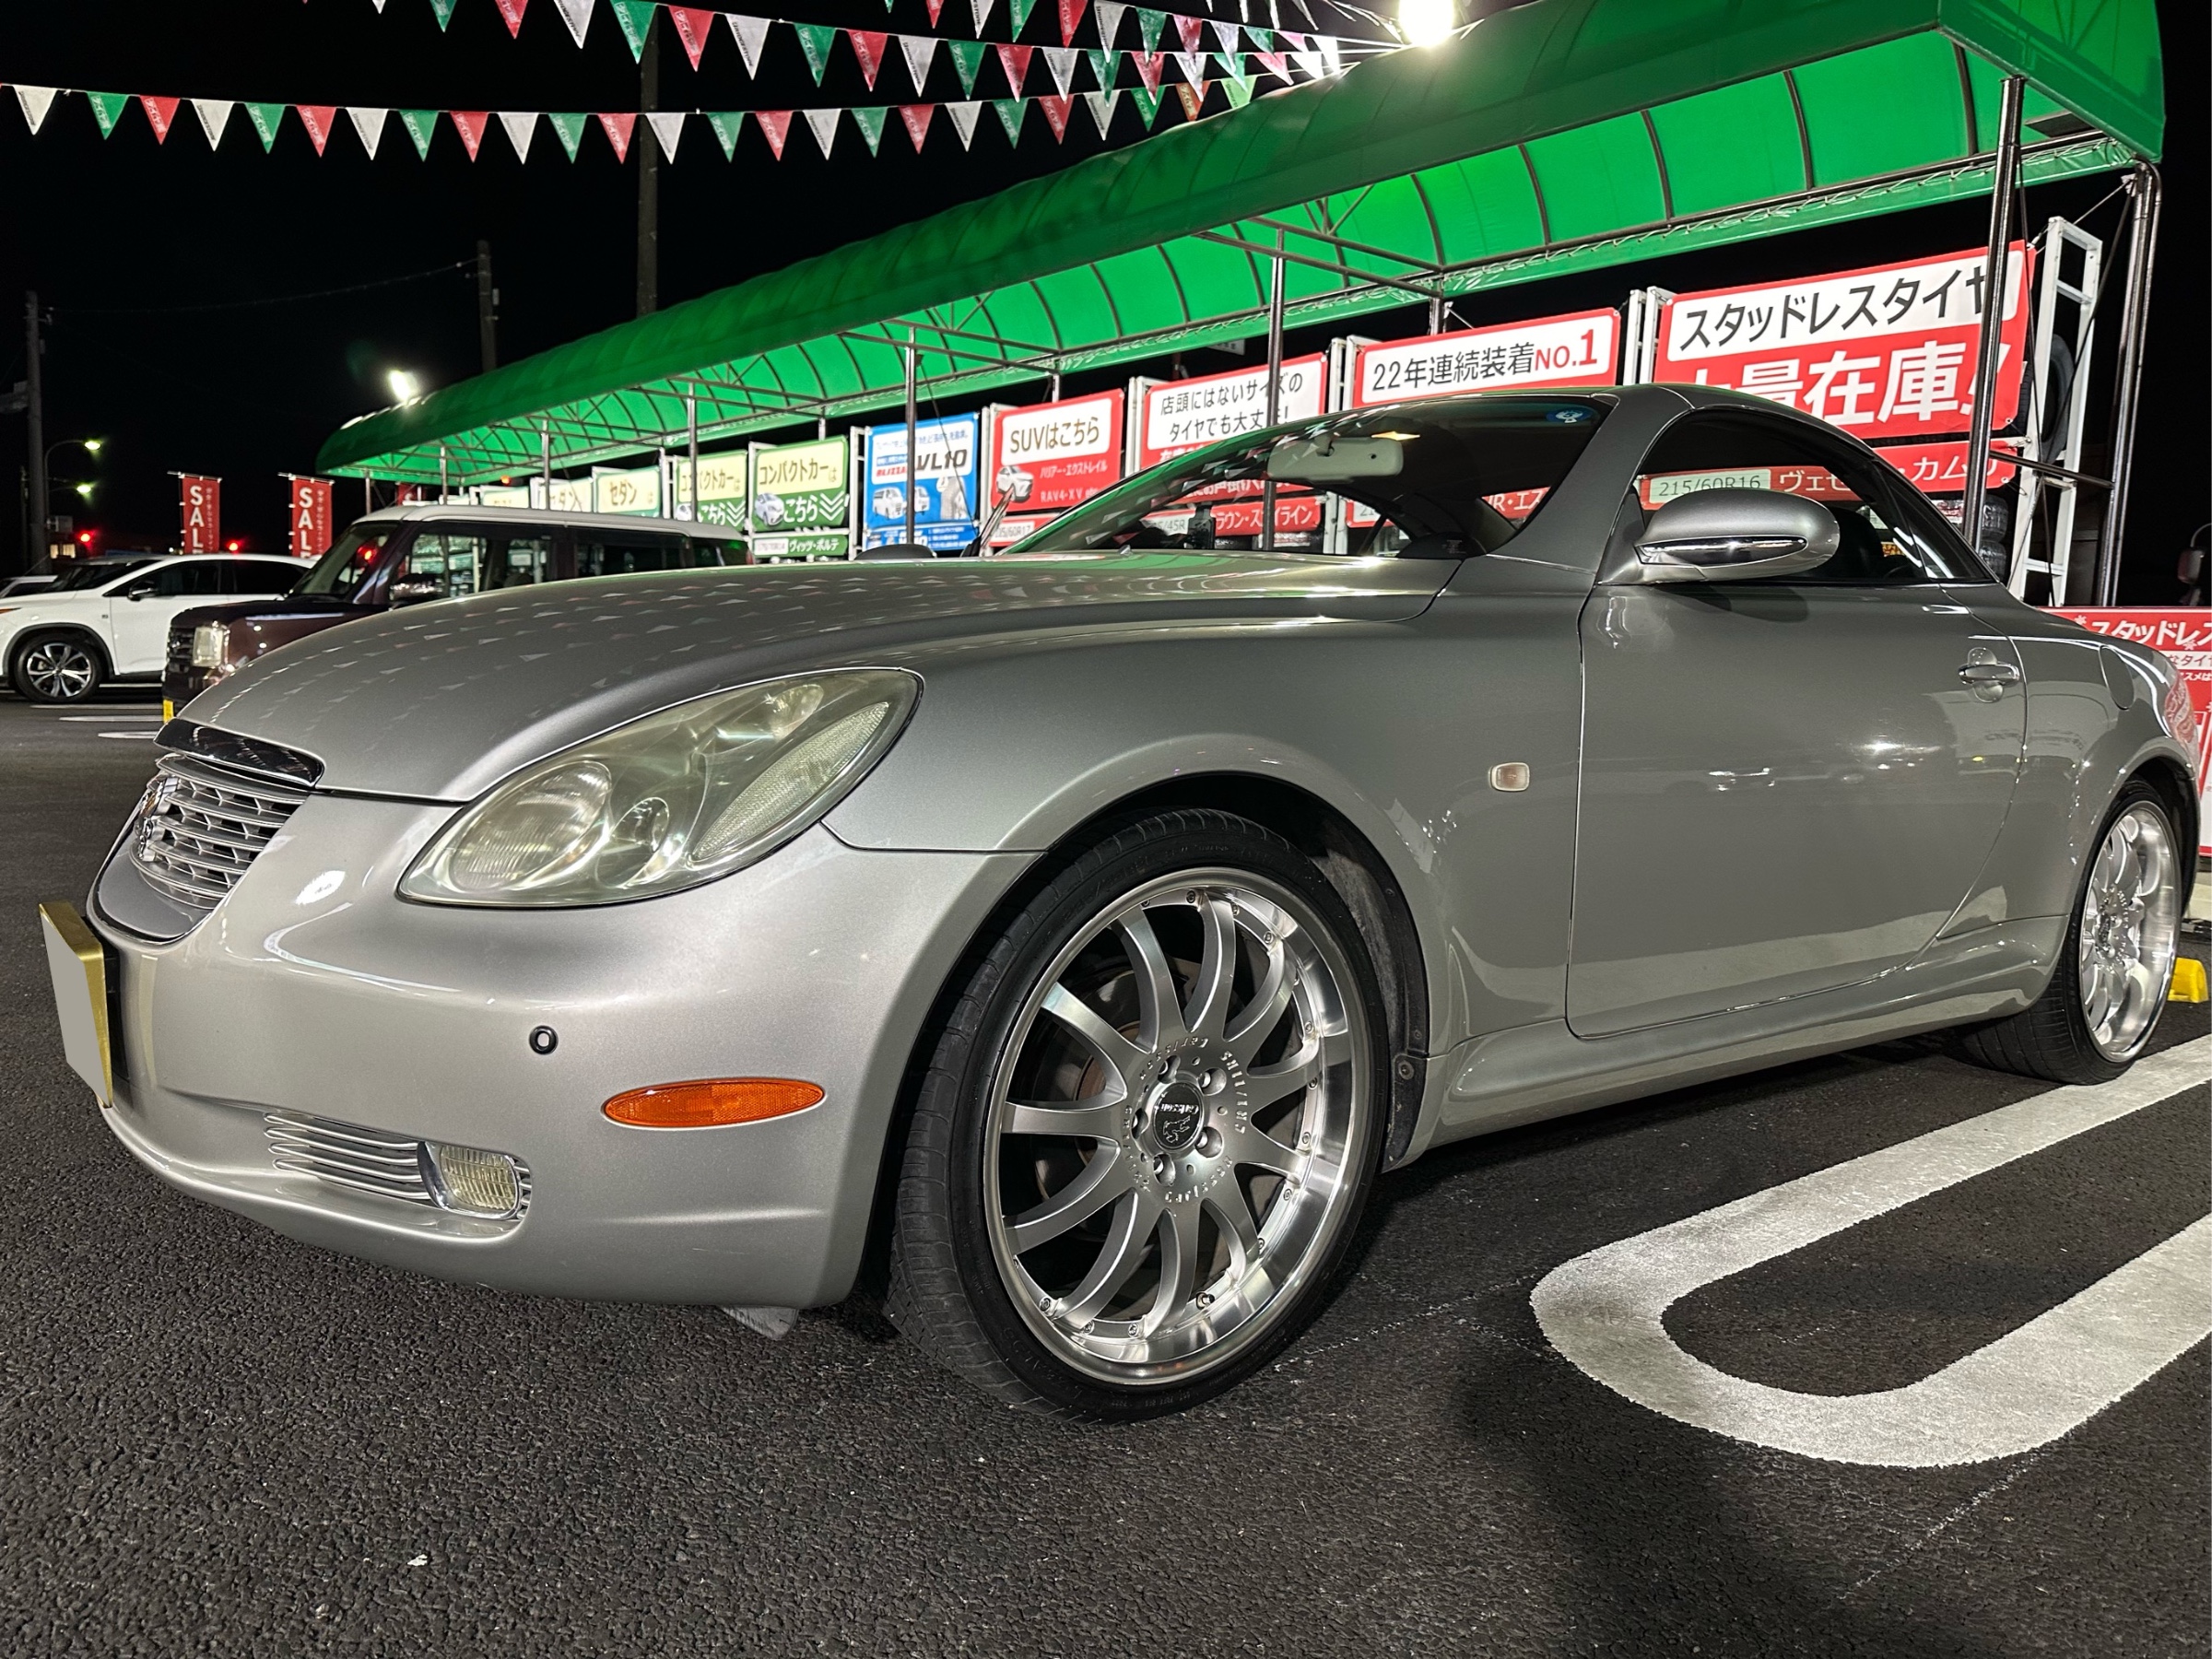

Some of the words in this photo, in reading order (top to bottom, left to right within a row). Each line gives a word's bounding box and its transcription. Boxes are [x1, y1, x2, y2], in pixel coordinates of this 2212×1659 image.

[1694, 341, 2011, 425] 量在庫!
[1010, 416, 1100, 453] SUVはこちら
[1170, 406, 1288, 442] タイヤでも大丈!
[1659, 475, 1761, 497] 215/60R16
[189, 485, 205, 553] SAL
[299, 487, 313, 559] SAL
[783, 494, 818, 523] こちら
[1215, 505, 1312, 531] ラウン・スイライン
